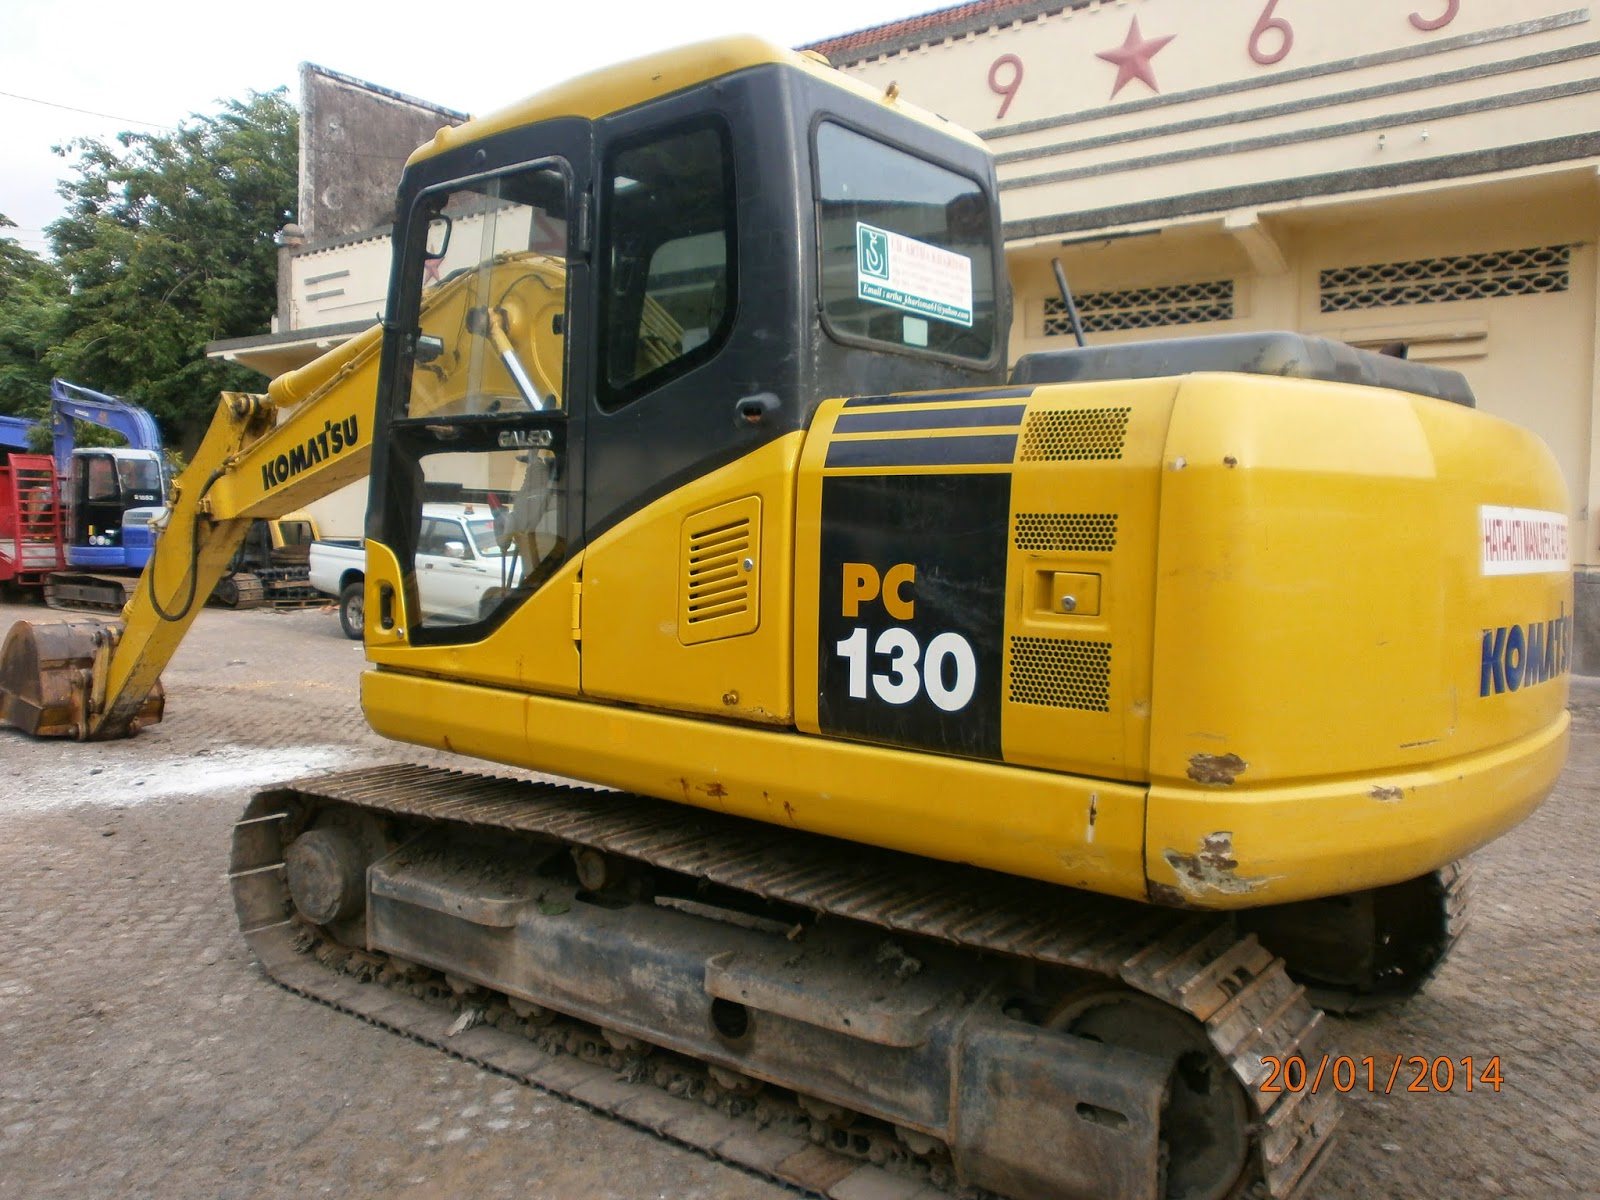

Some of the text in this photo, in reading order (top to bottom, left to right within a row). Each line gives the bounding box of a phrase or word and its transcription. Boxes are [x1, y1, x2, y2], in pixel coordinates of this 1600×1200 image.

[988, 0, 1294, 119] 9 6
[863, 283, 882, 297] Email
[261, 414, 358, 491] KOMATSU
[842, 562, 915, 621] PC
[836, 627, 977, 712] 130
